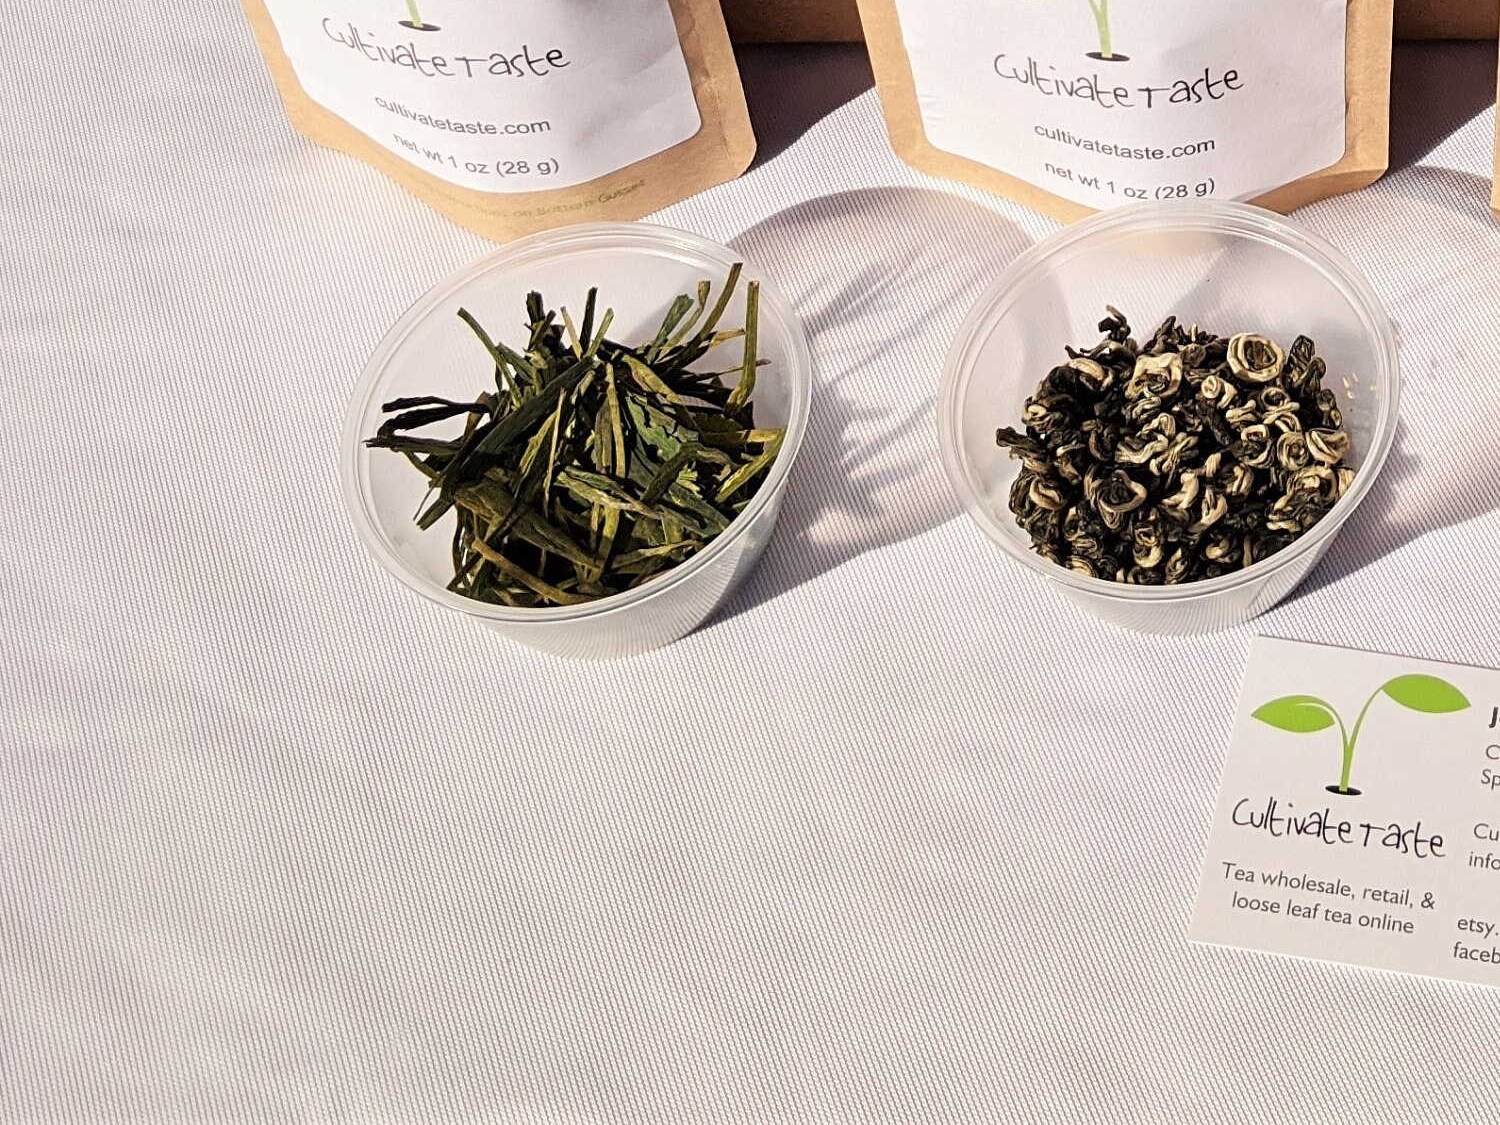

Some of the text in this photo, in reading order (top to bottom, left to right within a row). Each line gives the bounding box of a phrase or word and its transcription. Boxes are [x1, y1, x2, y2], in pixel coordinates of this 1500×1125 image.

[323, 18, 570, 77] Cultivate Taste
[994, 52, 1244, 108] Cultivate Taste
[375, 97, 551, 134] cultivatetaste.com
[392, 133, 560, 178] net wt 1 oz (28 g)
[1035, 126, 1215, 160] cultivatetaste.com
[1044, 162, 1215, 200] net wt 1 oz (28 g)
[1232, 797, 1445, 858] Cultivate Taste
[1221, 861, 1436, 910] Tea wholesale, retail, &
[1232, 890, 1415, 934] loose leaf tea online
